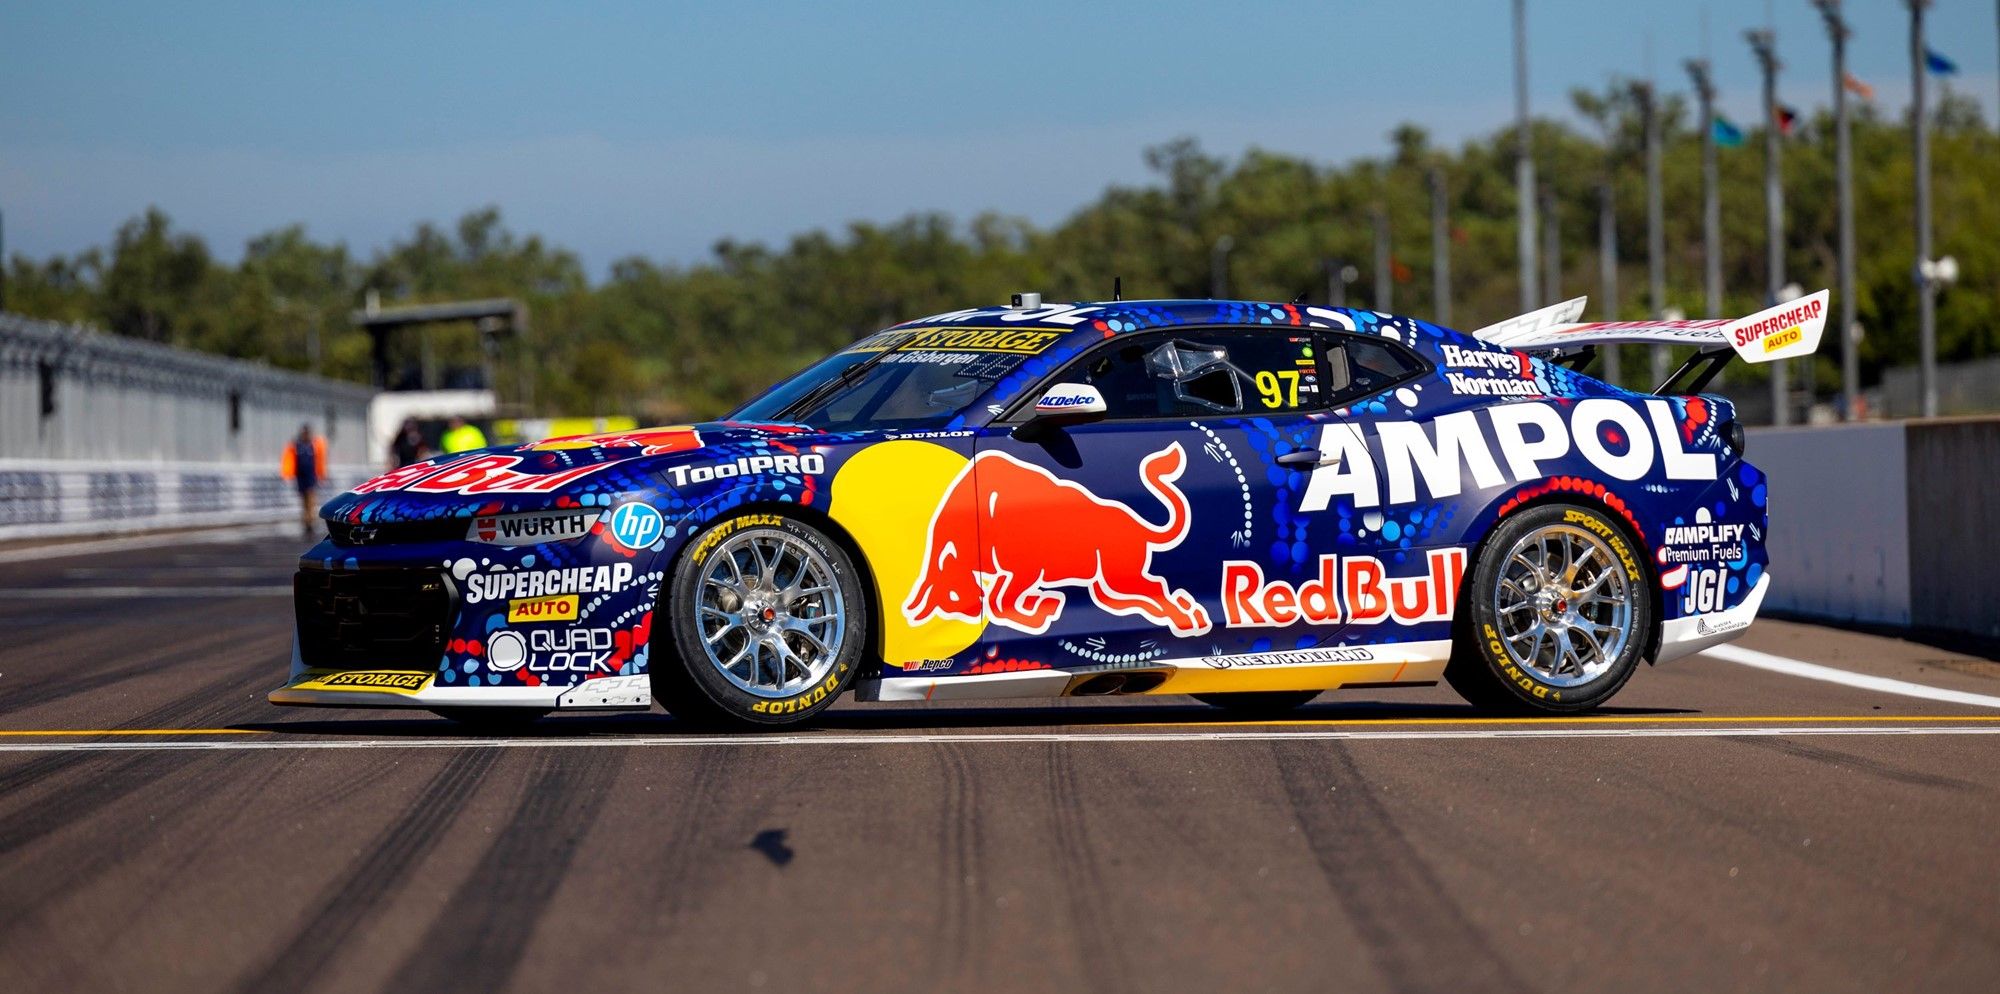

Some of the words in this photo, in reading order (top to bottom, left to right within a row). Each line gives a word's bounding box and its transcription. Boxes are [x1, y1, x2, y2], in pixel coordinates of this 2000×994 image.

[1734, 299, 1822, 347] SUPERCHEAP
[917, 329, 1059, 351] STORAGE
[1767, 331, 1798, 349] AUTO
[1440, 344, 1521, 374] Harvey
[1255, 370, 1300, 409] 97
[1445, 372, 1542, 395] Norman
[1038, 394, 1096, 408] ACDelco
[899, 430, 975, 439] DUNLOP
[1299, 398, 1718, 513] AMPOL
[667, 453, 825, 487] ToolPRO
[500, 514, 586, 538] WÜRTH
[620, 503, 653, 548] hp
[736, 514, 785, 530] MAXX
[1674, 523, 1745, 545] AMPLIFY
[1563, 509, 1613, 538] SPORT
[1608, 536, 1641, 582] MAXX
[1666, 545, 1710, 562] Premium
[1711, 542, 1742, 561] Fuels
[465, 562, 634, 604] SUPERCHEAP
[1221, 554, 1340, 628] Red
[1343, 547, 1469, 626] Bull
[1684, 568, 1728, 614] JGI
[514, 600, 571, 617] AUTO
[530, 628, 612, 653] QUAD
[529, 651, 613, 672] LOCK
[920, 658, 954, 672] Repco
[1229, 654, 1283, 666] NEW
[1280, 648, 1374, 664] HOLLAND
[1483, 623, 1550, 699] DUNLOP
[332, 673, 426, 688] STORAGE
[752, 673, 840, 714] DUNLOP
